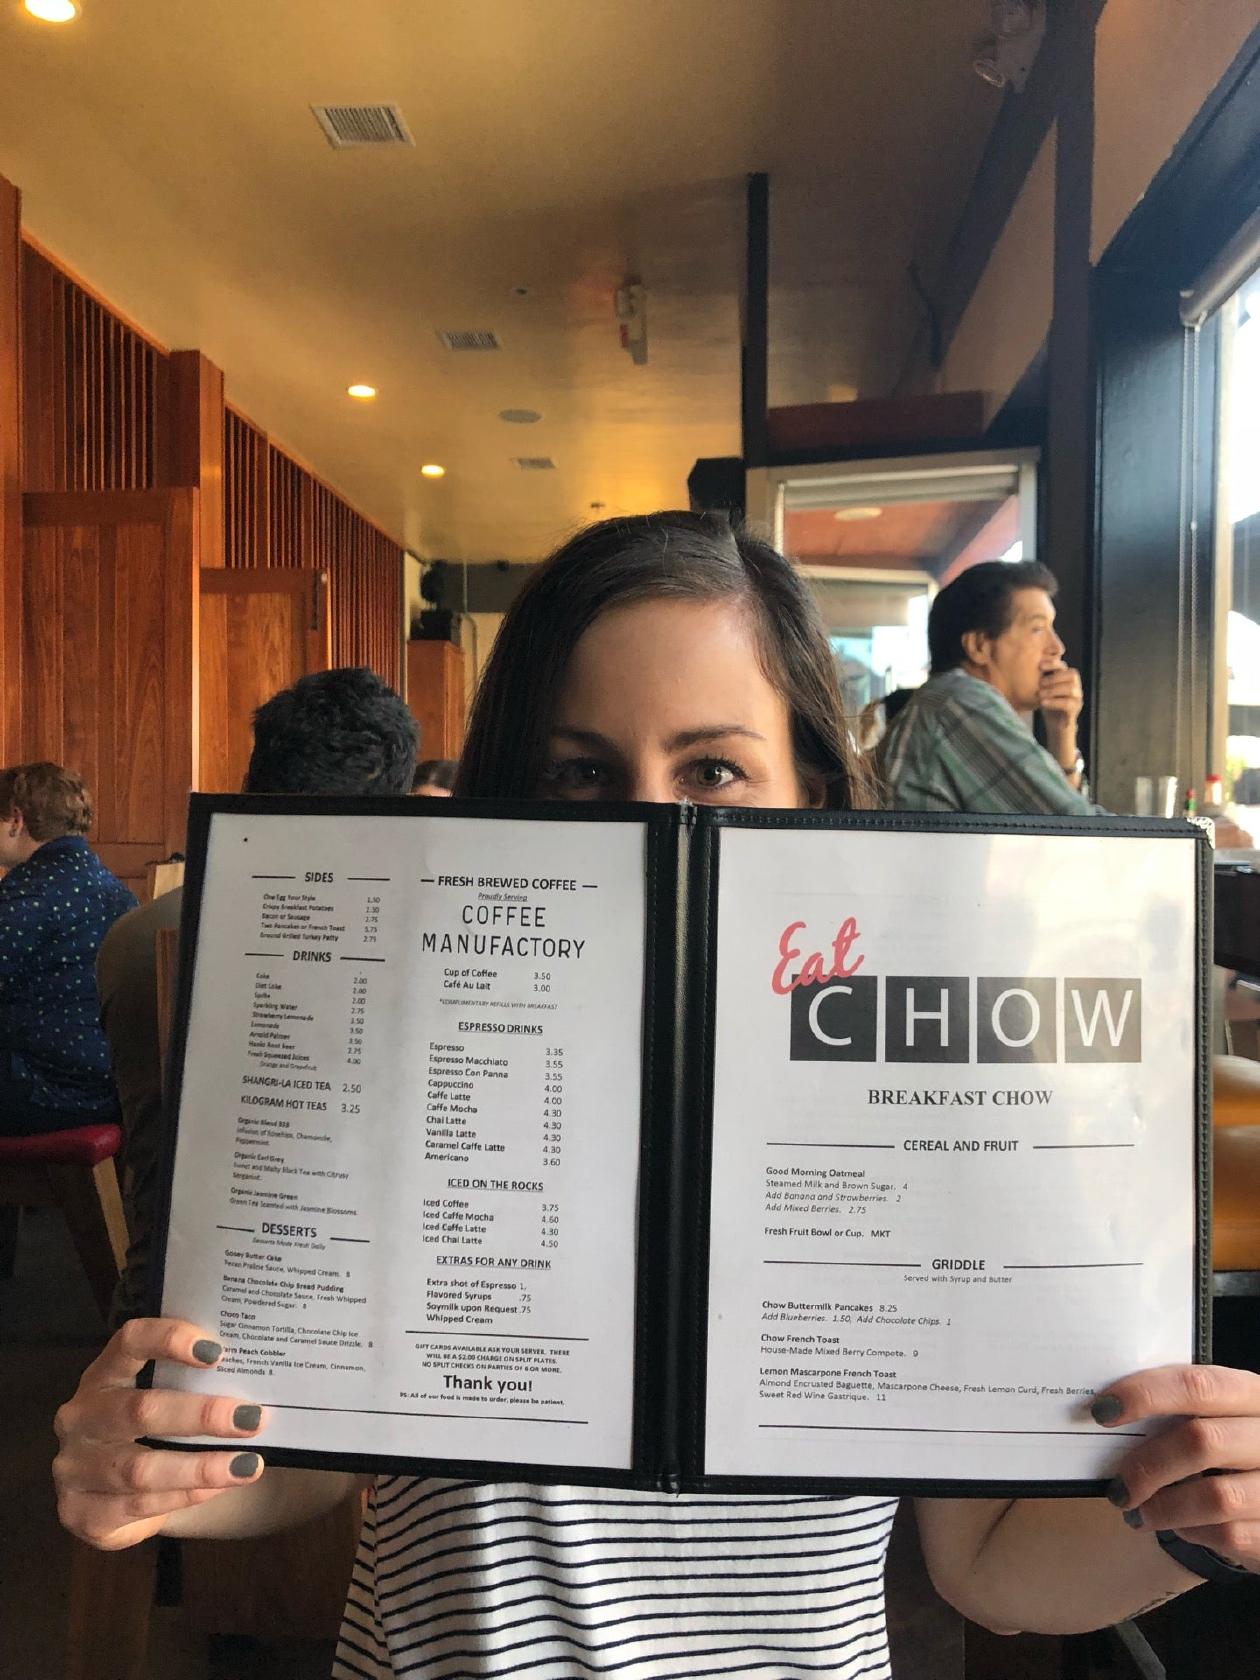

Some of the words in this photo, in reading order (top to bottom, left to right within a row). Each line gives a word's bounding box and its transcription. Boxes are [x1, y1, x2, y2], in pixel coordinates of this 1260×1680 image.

[305, 872, 333, 883] SIDES
[438, 876, 473, 887] FRESH
[478, 878, 528, 889] BREWED
[532, 878, 576, 891] COFFEE
[462, 905, 546, 927] COFFEE
[422, 933, 585, 959] MANUFACTORY
[293, 951, 332, 962] DRINKS
[771, 916, 864, 995] Eat
[444, 968, 459, 977] Cup
[472, 969, 497, 978] Coffee
[534, 972, 550, 980] 3.50
[444, 980, 460, 988] Café
[476, 982, 490, 990] Lait
[534, 984, 550, 992] 3.00
[809, 985, 1133, 1047] CHOW
[458, 1022, 505, 1033] ESPRESSO
[507, 1024, 543, 1034] DRINKS
[430, 1042, 464, 1052] Espresso
[430, 1055, 463, 1064] Espresso
[466, 1057, 508, 1066] Macchiato
[429, 1067, 463, 1076] Espresso
[483, 1070, 508, 1078] Panna
[242, 1076, 291, 1088] SHANGRI-LA
[294, 1080, 312, 1089] ICED
[316, 1081, 331, 1091] TEA
[342, 1083, 361, 1093] 2.50
[428, 1080, 473, 1089] Cappuccino
[428, 1091, 448, 1100] Caffe
[451, 1093, 470, 1101] Latte
[868, 1089, 986, 1106] BREAKFAST
[992, 1090, 1053, 1105] CHOW
[241, 1096, 283, 1108] KILOGRAM
[286, 1099, 303, 1109] HOT
[307, 1101, 327, 1110] TEAS
[341, 1104, 360, 1113] 3.25
[427, 1103, 447, 1112] Caffe
[450, 1105, 477, 1113] Mocha
[427, 1116, 444, 1124] Chai
[446, 1117, 466, 1125] Latte
[426, 1128, 453, 1137] Vanilla
[456, 1130, 476, 1138] Latte
[425, 1140, 458, 1149] Caramel
[462, 1142, 482, 1150] Caffe
[485, 1144, 505, 1152] Latte
[904, 1140, 949, 1151] CEREAL
[954, 1140, 980, 1151] AND
[985, 1140, 1018, 1151] FRUIT
[425, 1152, 469, 1162] Americano
[543, 1158, 560, 1166] 3.60
[766, 1167, 788, 1175] Good
[792, 1168, 827, 1178] Morning
[829, 1169, 864, 1177] Oatmeal
[448, 1179, 469, 1188] ICED
[472, 1179, 487, 1188] ON
[491, 1180, 508, 1189] THE
[512, 1181, 543, 1191] ROCKS
[766, 1180, 801, 1188] Steamed
[805, 1180, 822, 1188] Milk
[843, 1182, 868, 1190] Brown
[784, 1192, 815, 1200] Banana
[818, 1193, 833, 1201] and
[423, 1199, 440, 1207] Iced
[443, 1200, 468, 1208] Coffee
[784, 1204, 809, 1212] Mixed
[849, 1206, 866, 1214] 2.75
[423, 1211, 439, 1219] Iced
[443, 1212, 463, 1220] Caffe
[465, 1213, 494, 1222] Mocha
[262, 1222, 317, 1237] DESSERTS
[442, 1224, 463, 1232] Caffe
[465, 1225, 486, 1233] Latte
[765, 1227, 787, 1235] Fresh
[789, 1228, 809, 1236] Fruit
[811, 1228, 832, 1236] Bowl
[871, 1230, 891, 1238] MKT
[442, 1236, 459, 1244] Chai
[541, 1240, 558, 1248] 4.50
[437, 1256, 472, 1265] EXTRAS
[476, 1257, 494, 1265] FOR
[498, 1258, 517, 1267] ANY
[521, 1259, 551, 1268] DRINK
[932, 1259, 985, 1270] GRIDDLE
[427, 1279, 447, 1287] Extra
[471, 1280, 479, 1288] of
[481, 1281, 516, 1290] Espresso
[427, 1291, 462, 1299] Flavored
[465, 1292, 491, 1301] Syrups
[427, 1303, 458, 1312] Soymilk
[461, 1304, 482, 1313] upon
[485, 1306, 517, 1314] Request
[762, 1301, 786, 1309] Chow
[788, 1302, 831, 1311] Buttermilk
[835, 1304, 873, 1312] Pancakes
[427, 1314, 463, 1324] Whipped
[466, 1315, 492, 1324] Cream
[761, 1334, 785, 1342] Chow
[787, 1335, 815, 1343] French
[761, 1346, 812, 1355] House-Made
[815, 1347, 839, 1355] Mixed
[842, 1348, 864, 1356] Berry
[791, 1368, 841, 1377] Mascarpone
[844, 1369, 871, 1377] French
[443, 1375, 492, 1390] Thank
[498, 1380, 532, 1393] you!
[760, 1379, 791, 1387] Almond
[794, 1380, 833, 1388] Encrusted
[836, 1381, 874, 1390] Baguette,
[878, 1382, 927, 1391] Mascarpone
[759, 1390, 783, 1398] Sweet
[805, 1391, 825, 1399] Wine
